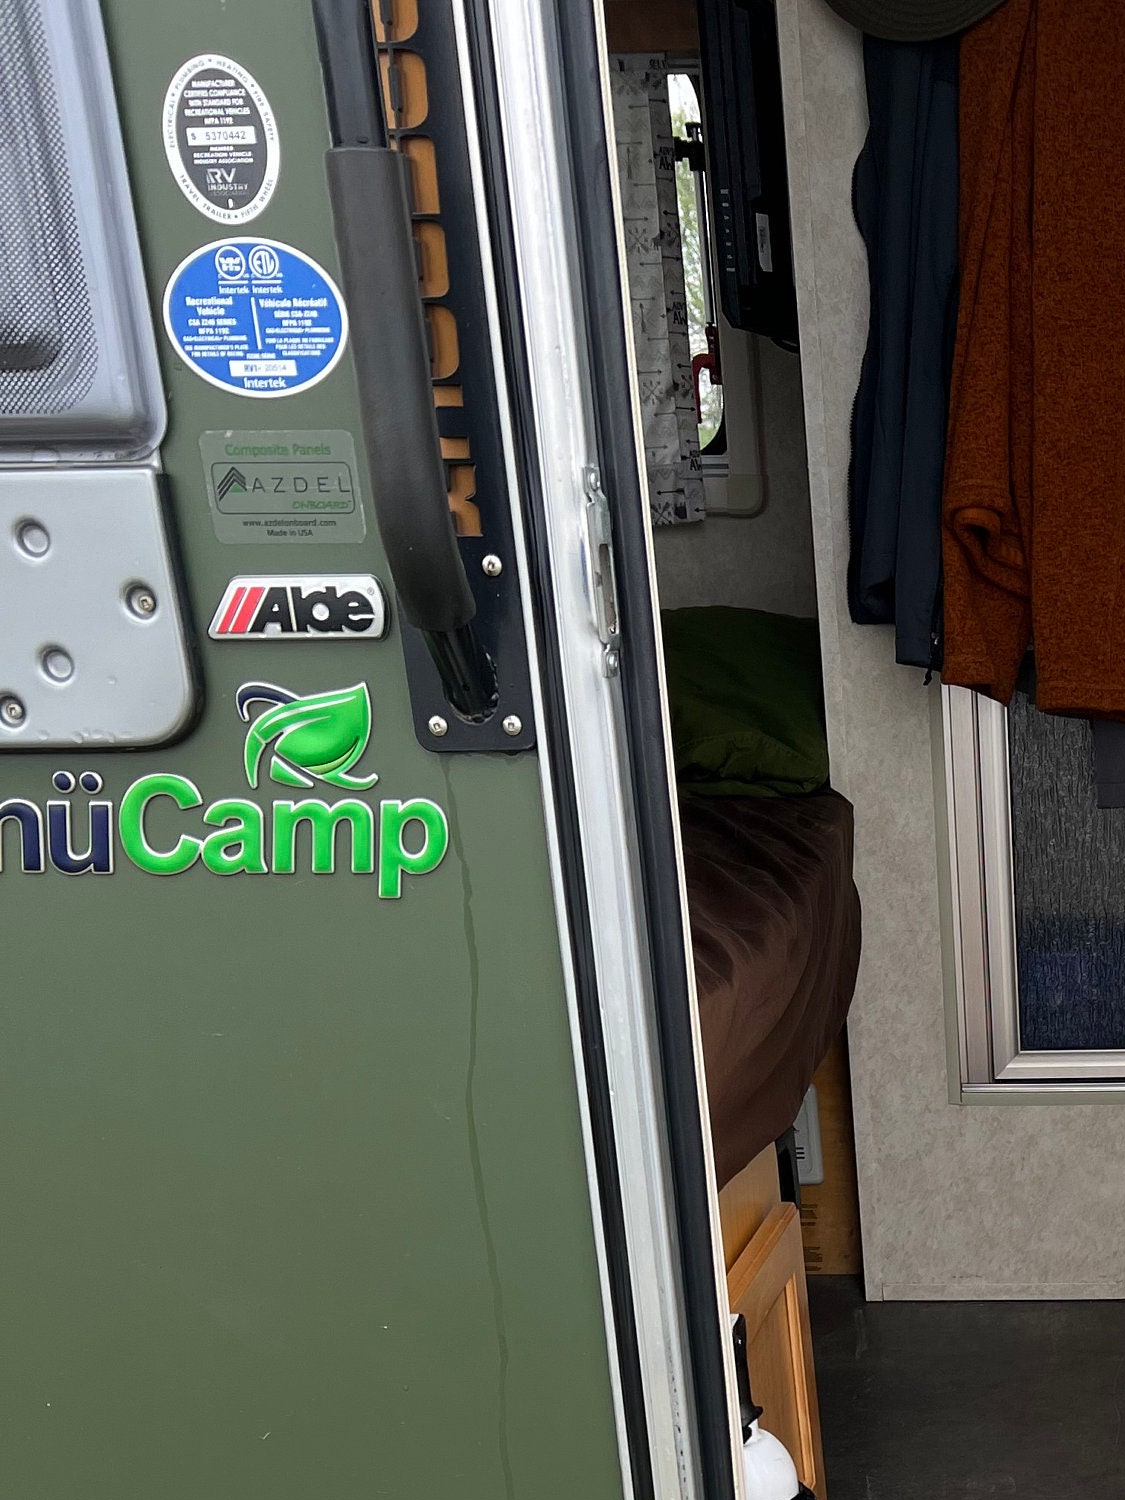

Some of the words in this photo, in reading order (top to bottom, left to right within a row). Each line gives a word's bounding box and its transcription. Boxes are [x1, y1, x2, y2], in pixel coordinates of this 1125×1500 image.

[216, 60, 249, 84] HEATING
[205, 130, 247, 141] 5370442
[206, 168, 236, 184] RV
[180, 174, 200, 203] TRAVEL
[202, 203, 232, 219] TRAILER
[243, 377, 287, 389] Intertek
[225, 443, 289, 457] Composite
[292, 443, 331, 456] Panels
[251, 476, 350, 493] AZDEL
[292, 500, 349, 510] ONBOARD
[242, 518, 336, 528] www.azdelonboard.com
[266, 529, 288, 537] Made
[289, 529, 297, 537] in
[298, 529, 313, 537] USA
[248, 586, 376, 633] Alde
[0, 770, 449, 898] nüCamp
